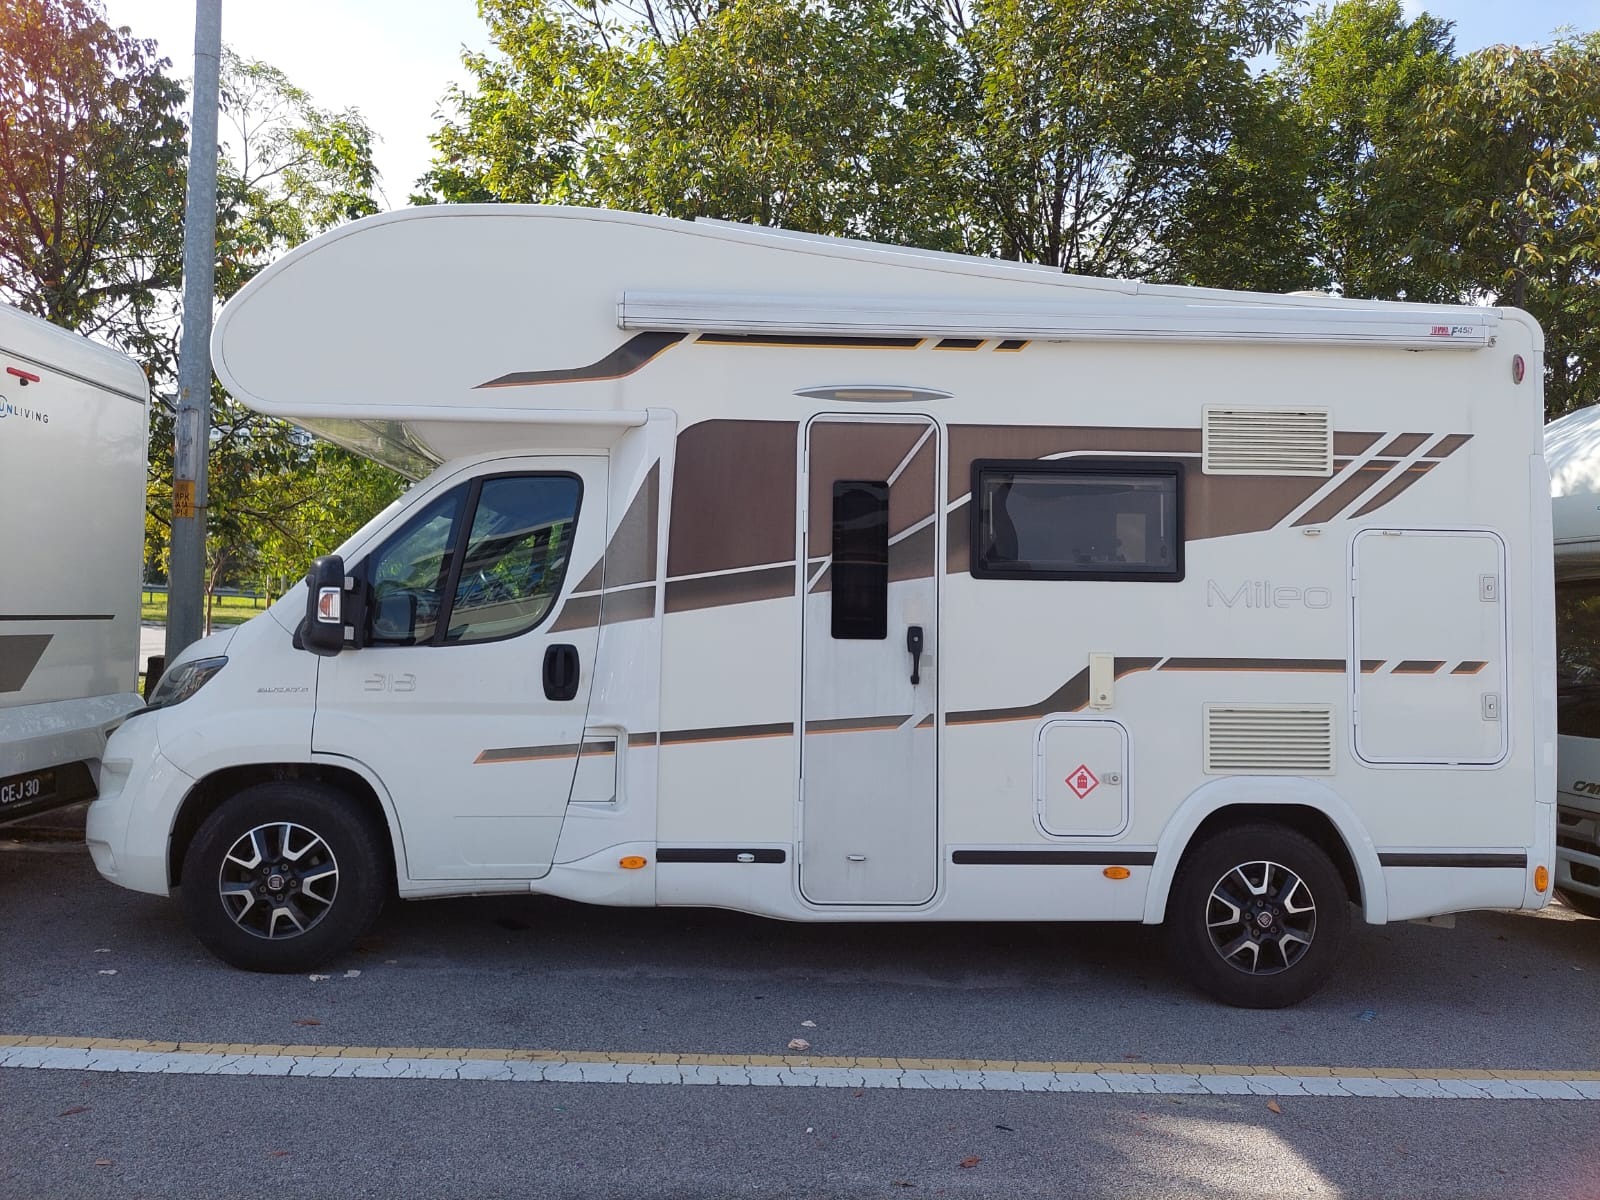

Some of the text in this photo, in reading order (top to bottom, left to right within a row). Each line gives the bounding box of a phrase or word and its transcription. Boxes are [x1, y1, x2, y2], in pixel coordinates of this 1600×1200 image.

[1206, 578, 1332, 609] Mileo
[364, 673, 417, 692] 313
[1, 778, 40, 803] CEJ 30
